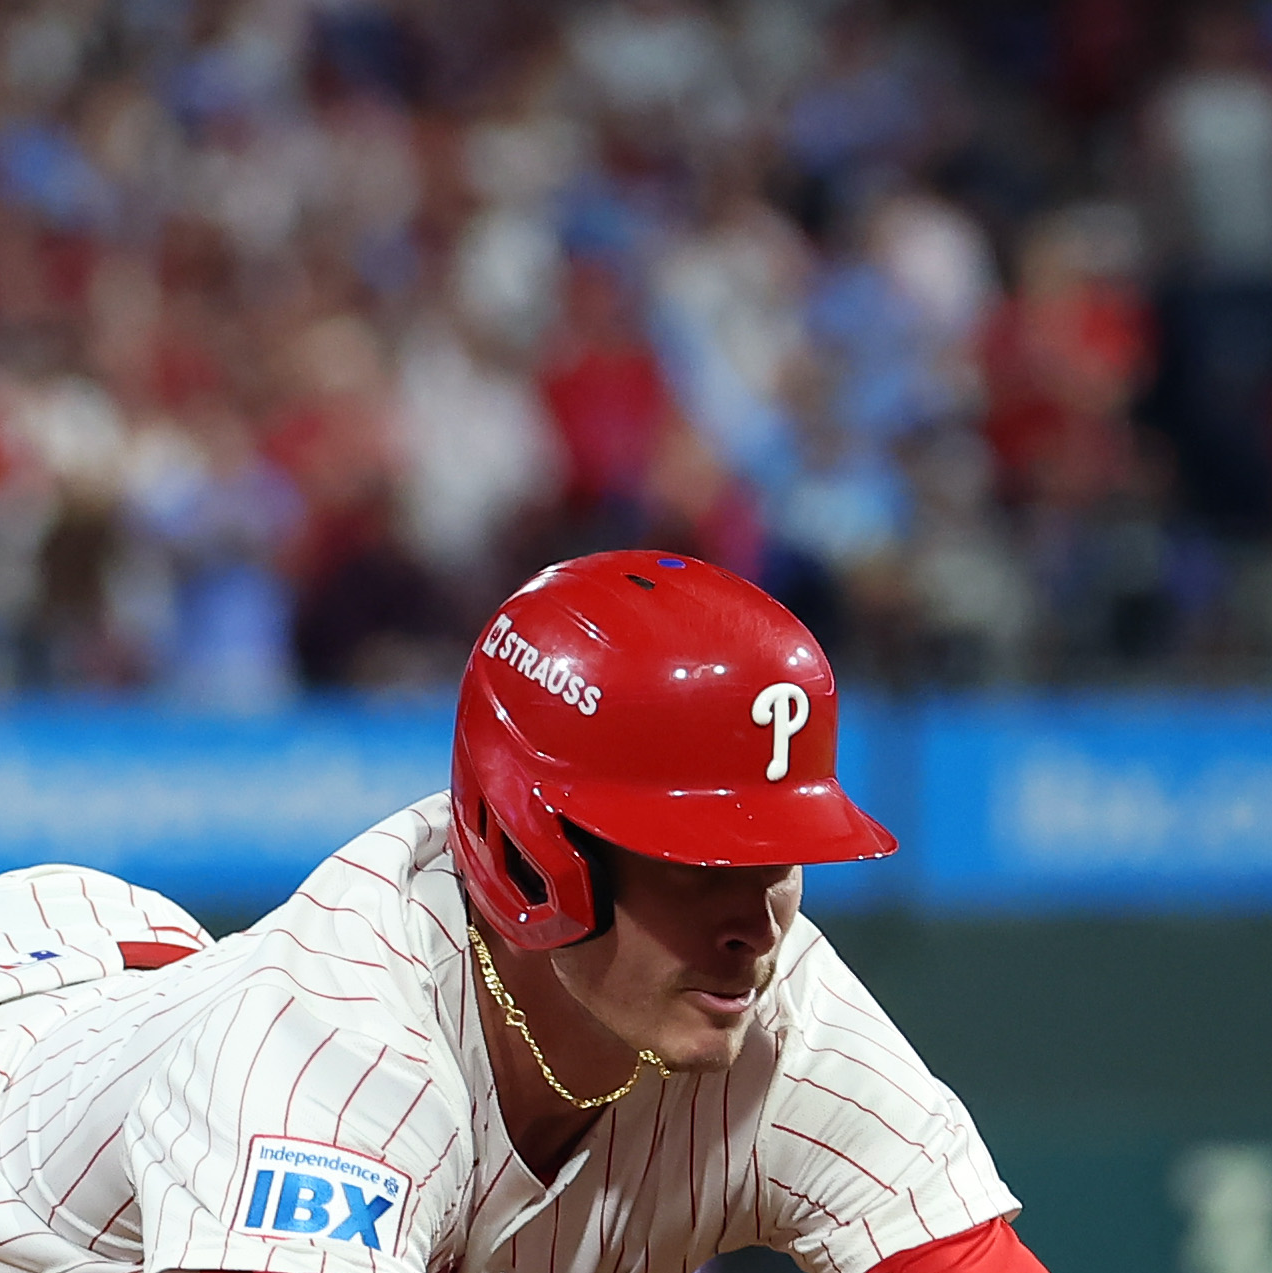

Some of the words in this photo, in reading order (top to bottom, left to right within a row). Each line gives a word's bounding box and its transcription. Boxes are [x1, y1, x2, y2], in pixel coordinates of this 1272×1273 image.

[498, 631, 603, 716] STRAUSS
[752, 682, 810, 781] P
[259, 1145, 381, 1185] Independence
[244, 1169, 395, 1252] IBX
